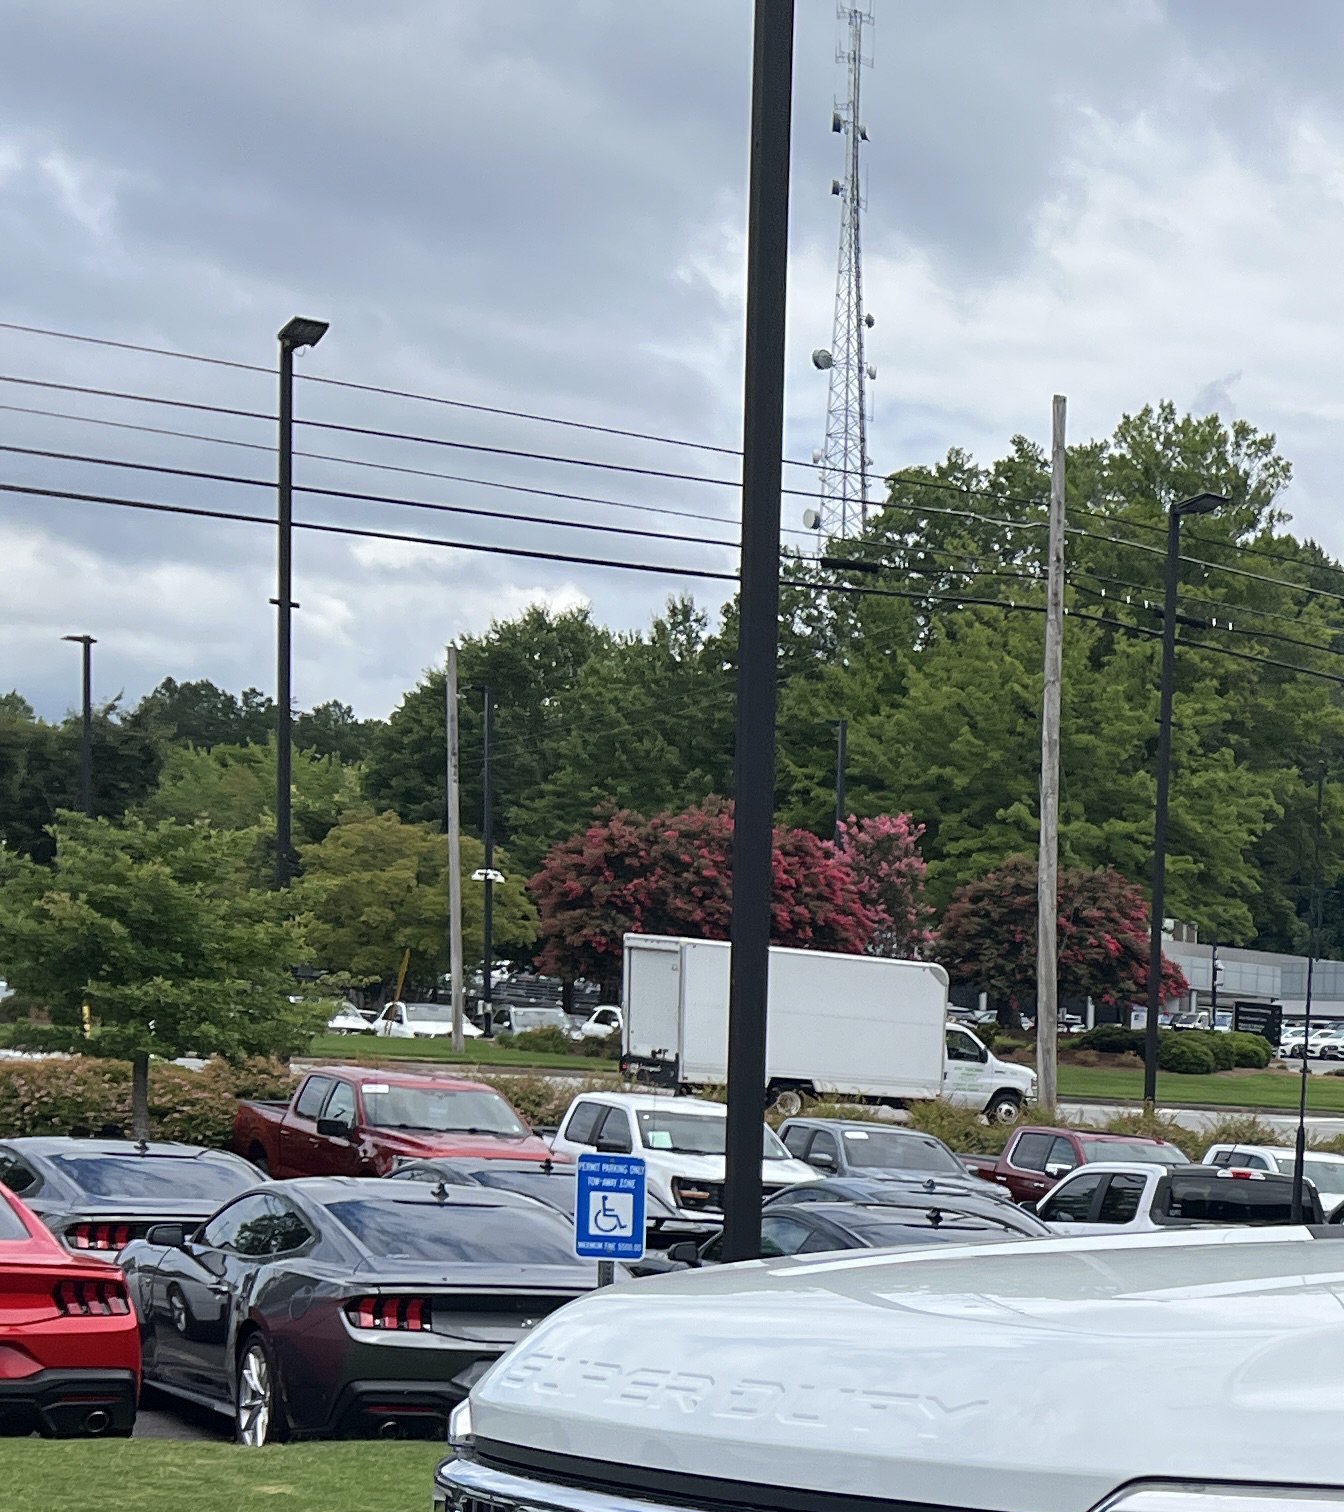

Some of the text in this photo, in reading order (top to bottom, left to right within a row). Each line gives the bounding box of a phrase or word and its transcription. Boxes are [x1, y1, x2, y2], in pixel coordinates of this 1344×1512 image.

[580, 1162, 645, 1176] PERMIT PARKING ONLY
[587, 1176, 637, 1189] TOW-AWAY ZONE
